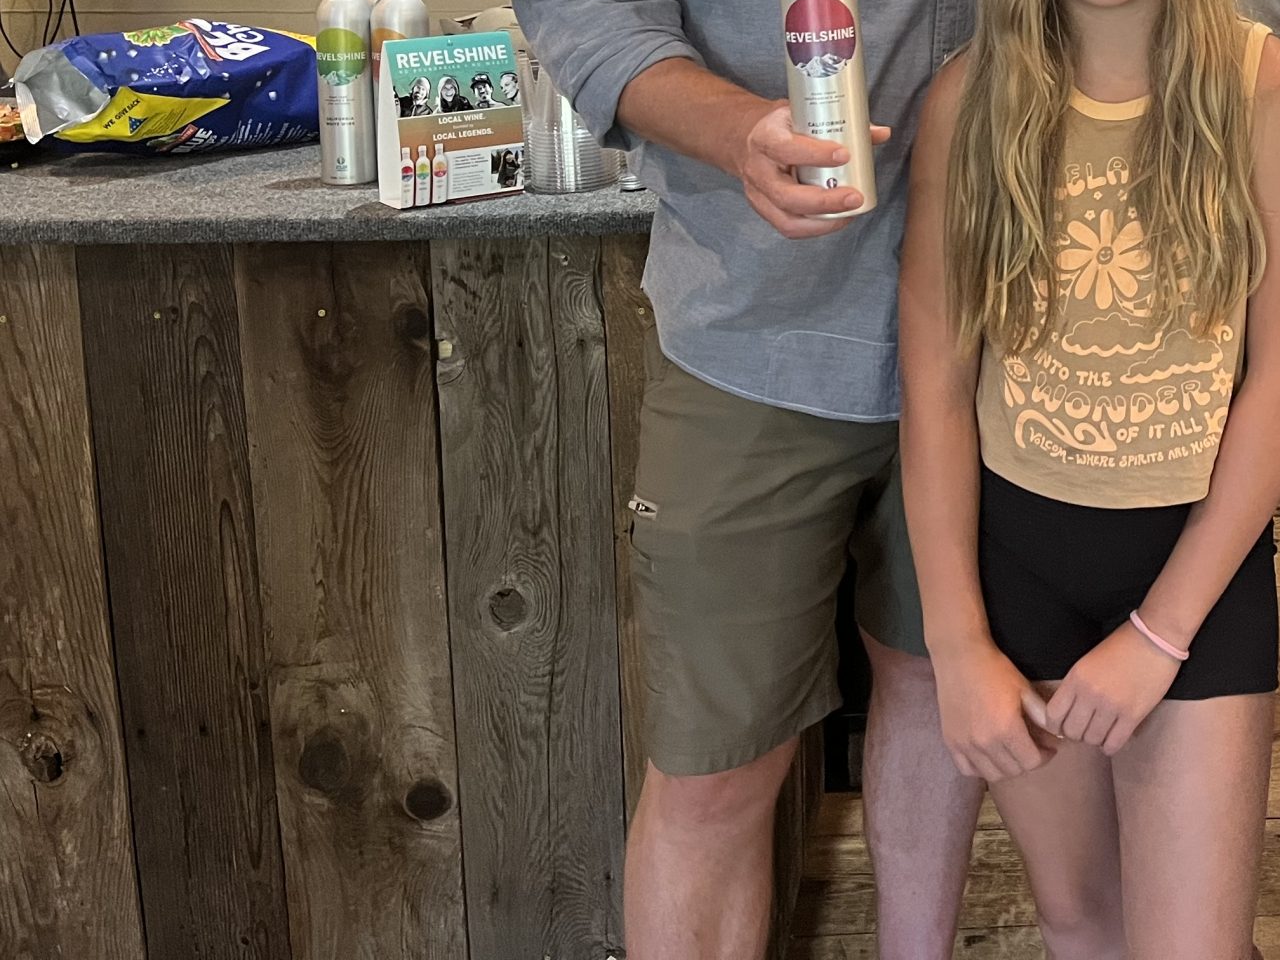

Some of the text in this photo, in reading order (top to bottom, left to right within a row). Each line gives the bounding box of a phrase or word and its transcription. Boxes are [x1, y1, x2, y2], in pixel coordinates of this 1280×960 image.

[785, 26, 855, 43] REVELSHINE
[395, 44, 508, 69] REVELSHINE
[103, 118, 116, 130] WE
[114, 107, 129, 121] GIVE
[126, 98, 141, 113] BACK
[438, 112, 486, 125] LOCAL WINE.
[433, 127, 495, 141] LOCAL LEGENDS.
[1033, 348, 1112, 387] INTO THE
[1031, 370, 1211, 423] WONDER
[1116, 417, 1203, 444] OF IT ALL
[1119, 450, 1164, 467] SPIRITS
[1168, 445, 1189, 461] ARE
